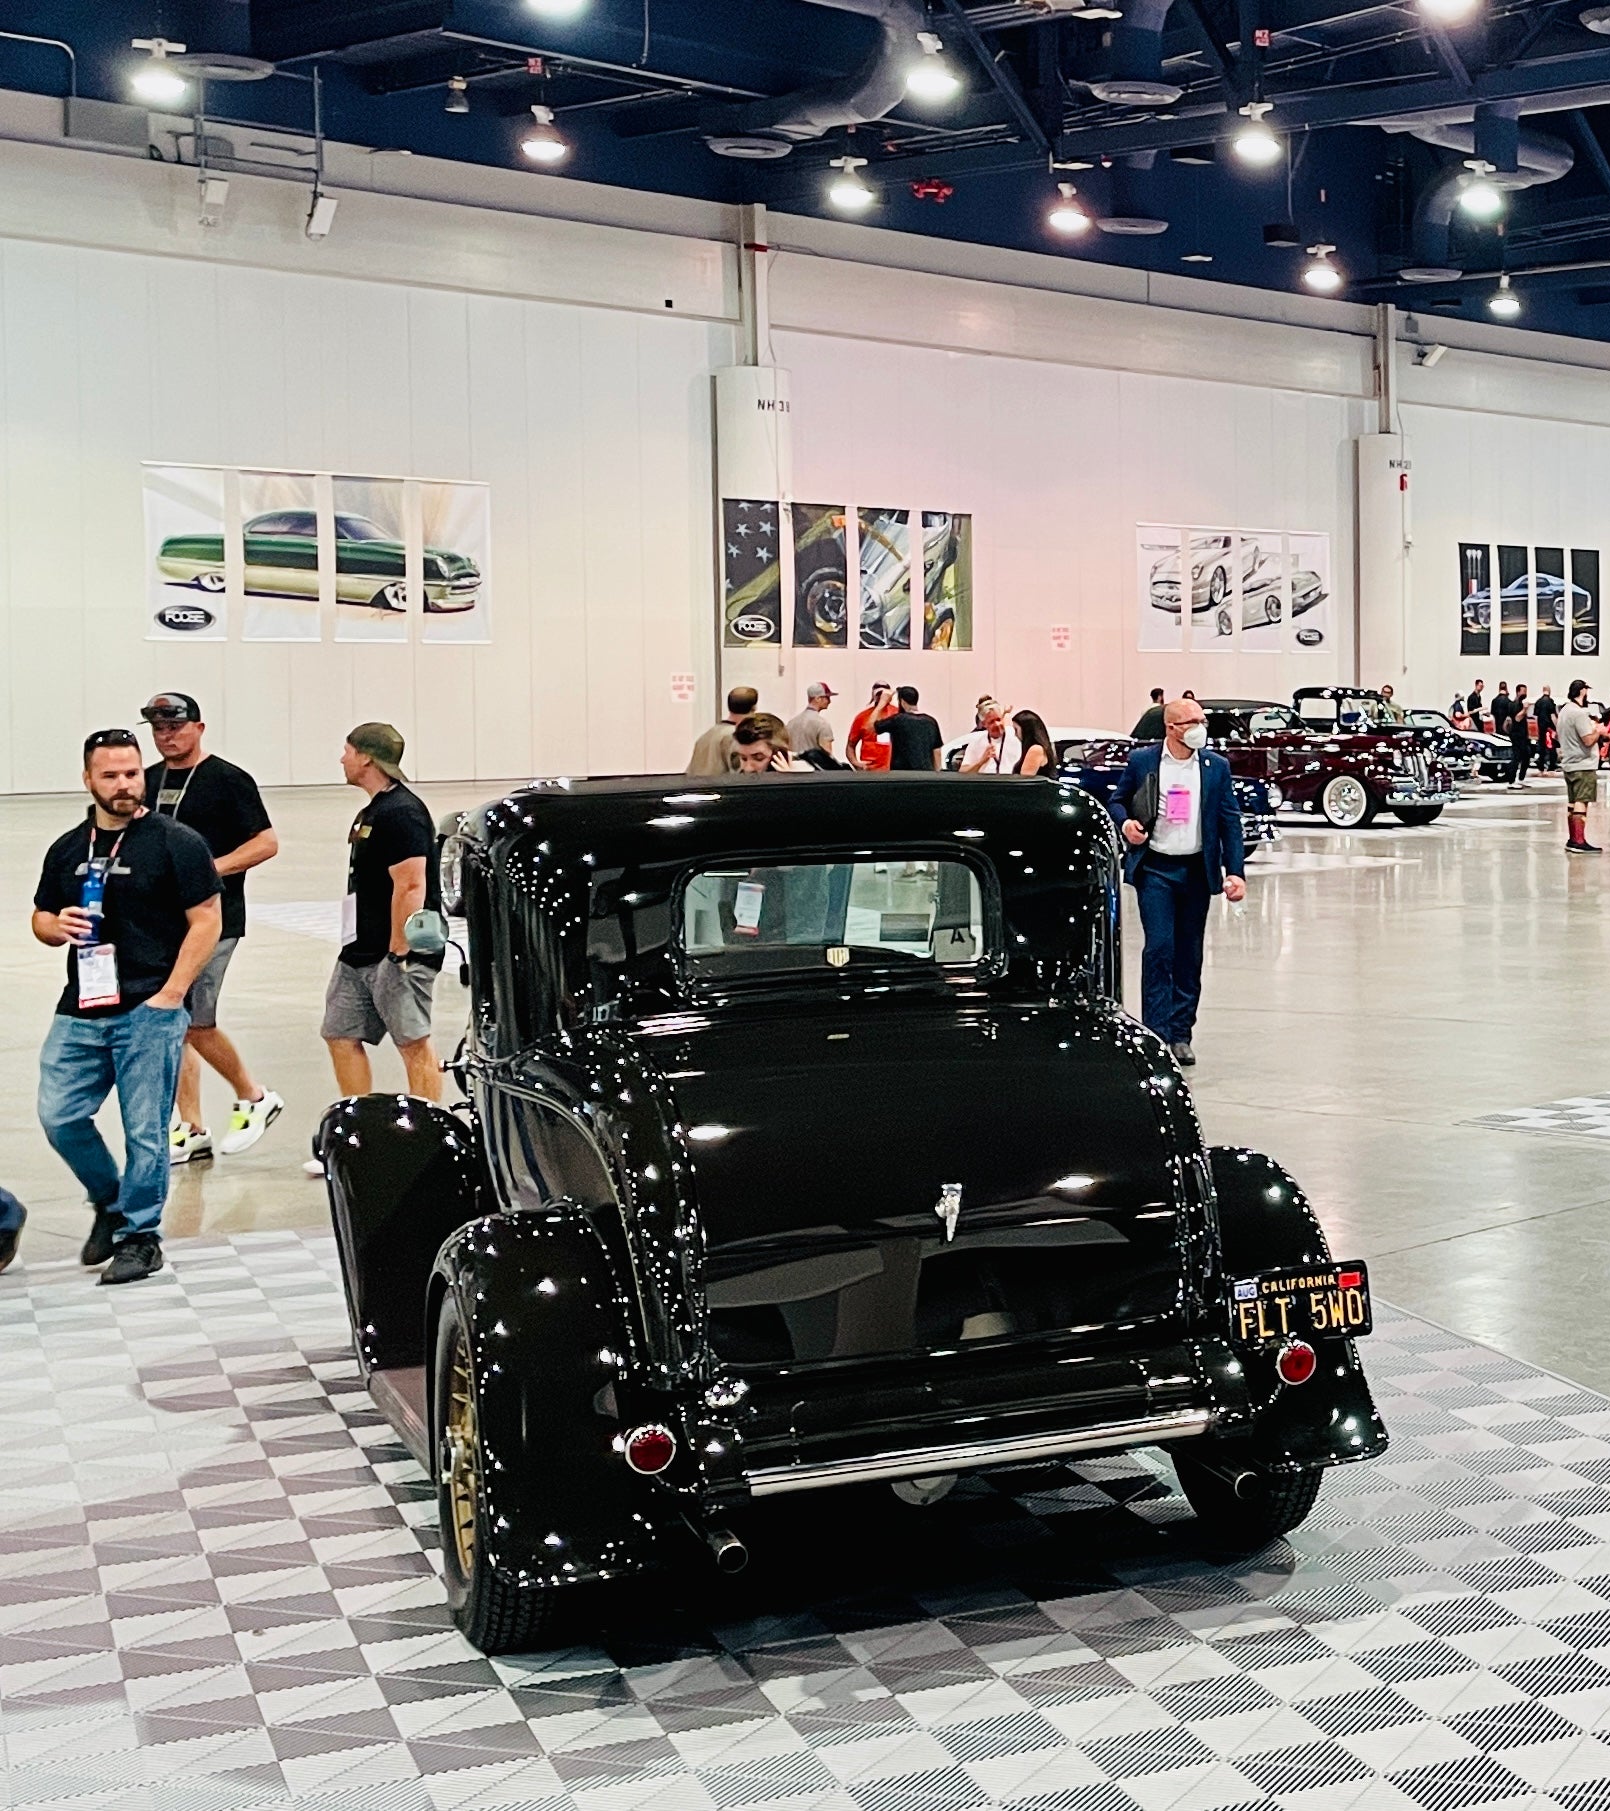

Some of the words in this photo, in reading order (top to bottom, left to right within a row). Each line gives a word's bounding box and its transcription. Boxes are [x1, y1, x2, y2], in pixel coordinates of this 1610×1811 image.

[1237, 1286, 1255, 1298] AUG
[1262, 1274, 1337, 1294] CALIFORNIA
[1239, 1297, 1290, 1340] FLT
